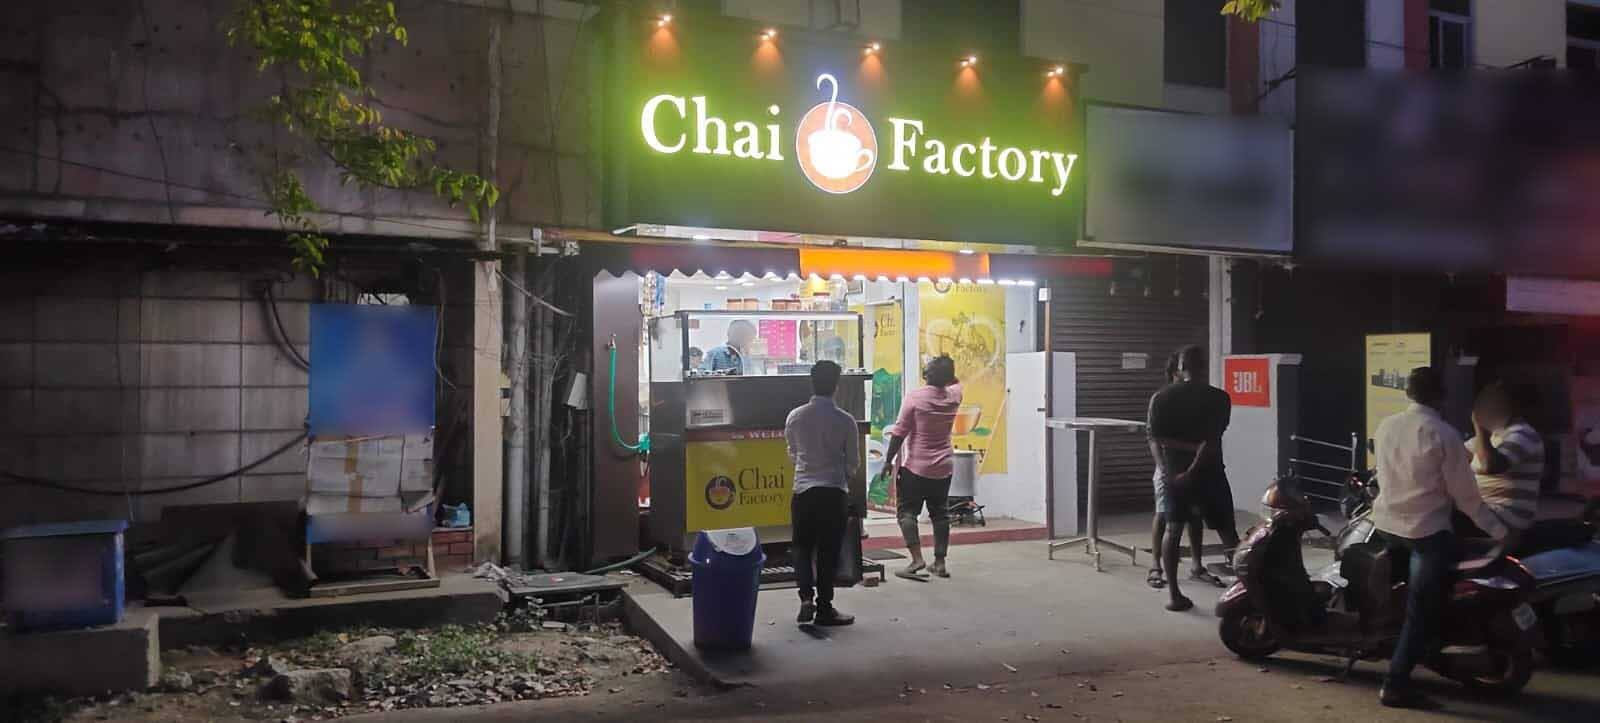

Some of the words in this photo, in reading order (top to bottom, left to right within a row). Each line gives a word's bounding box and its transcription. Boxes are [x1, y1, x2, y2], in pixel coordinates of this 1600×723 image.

[640, 94, 784, 161] Chai
[887, 117, 1079, 196] Factory
[1232, 371, 1263, 393] JBL
[738, 465, 785, 491] Chai
[738, 490, 785, 507] Factory
